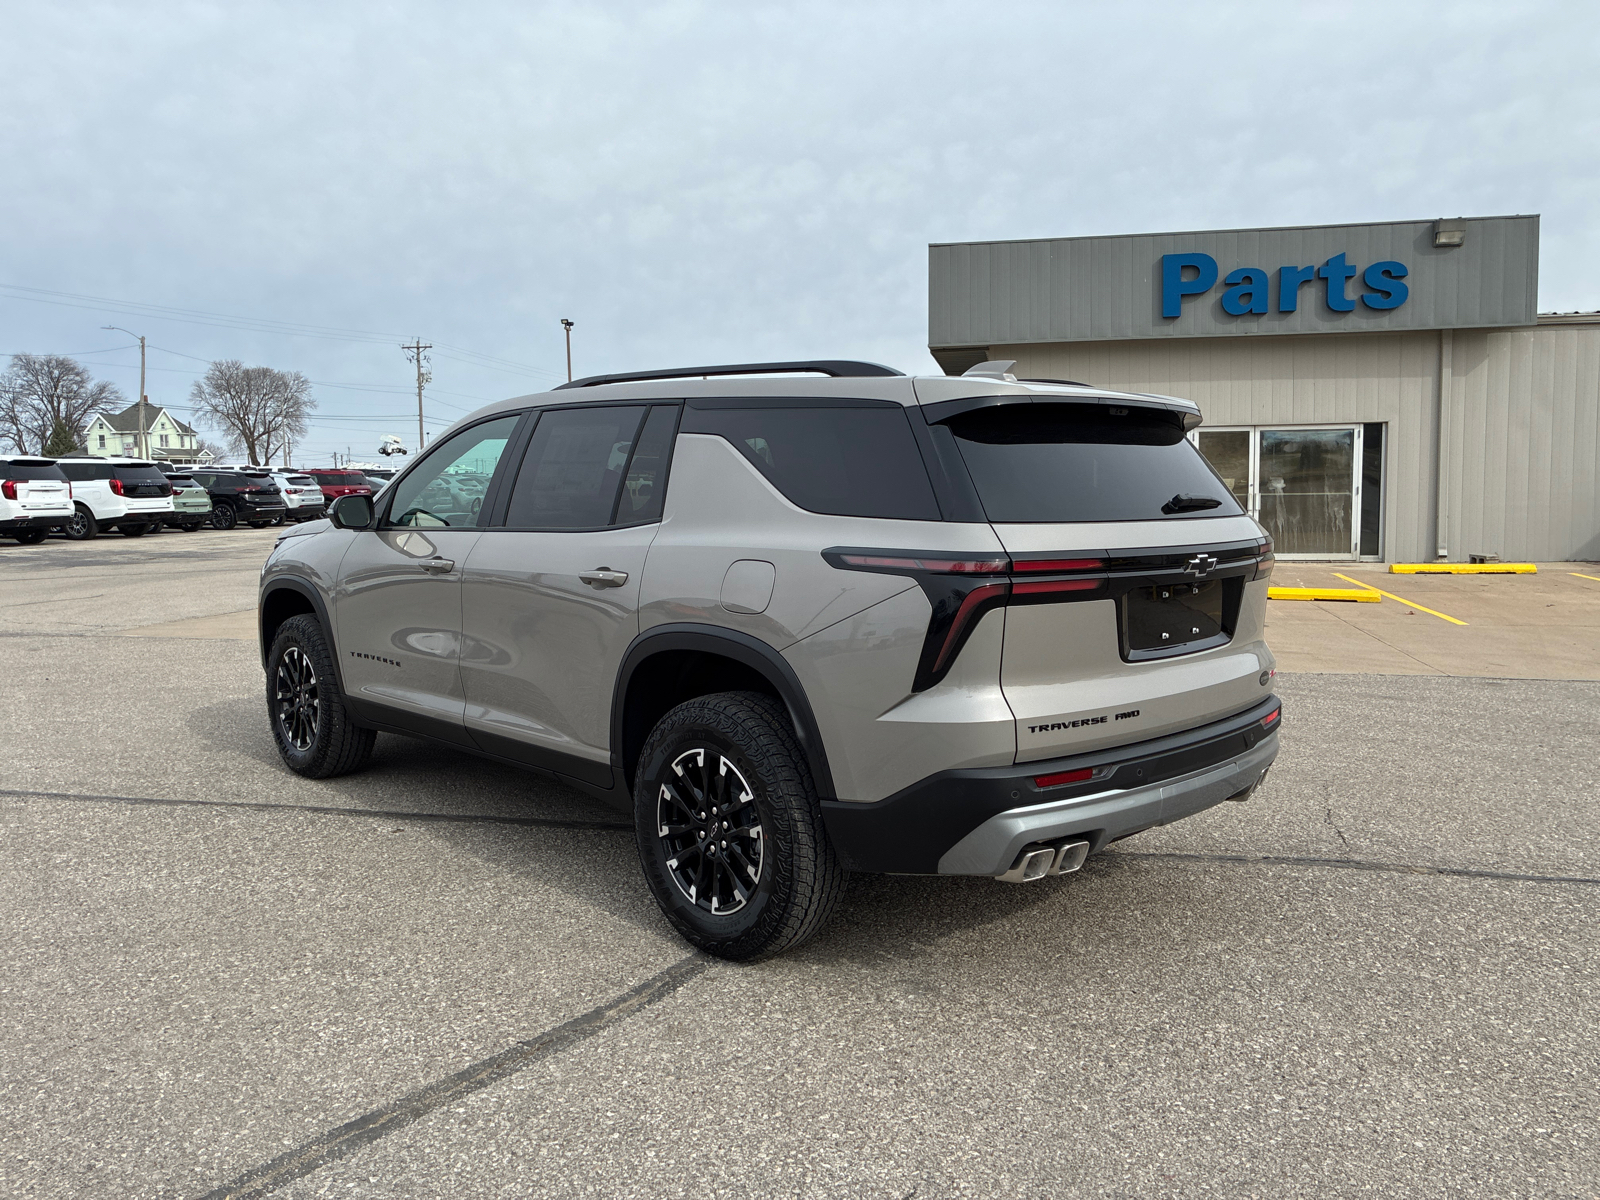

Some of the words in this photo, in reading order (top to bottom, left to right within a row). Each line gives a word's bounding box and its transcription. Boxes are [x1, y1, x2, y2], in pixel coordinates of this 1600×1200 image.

[1162, 252, 1408, 318] Parts
[350, 651, 401, 668] TRAVERSE
[1028, 715, 1108, 733] TRAVERSE
[1115, 709, 1140, 721] AWD
